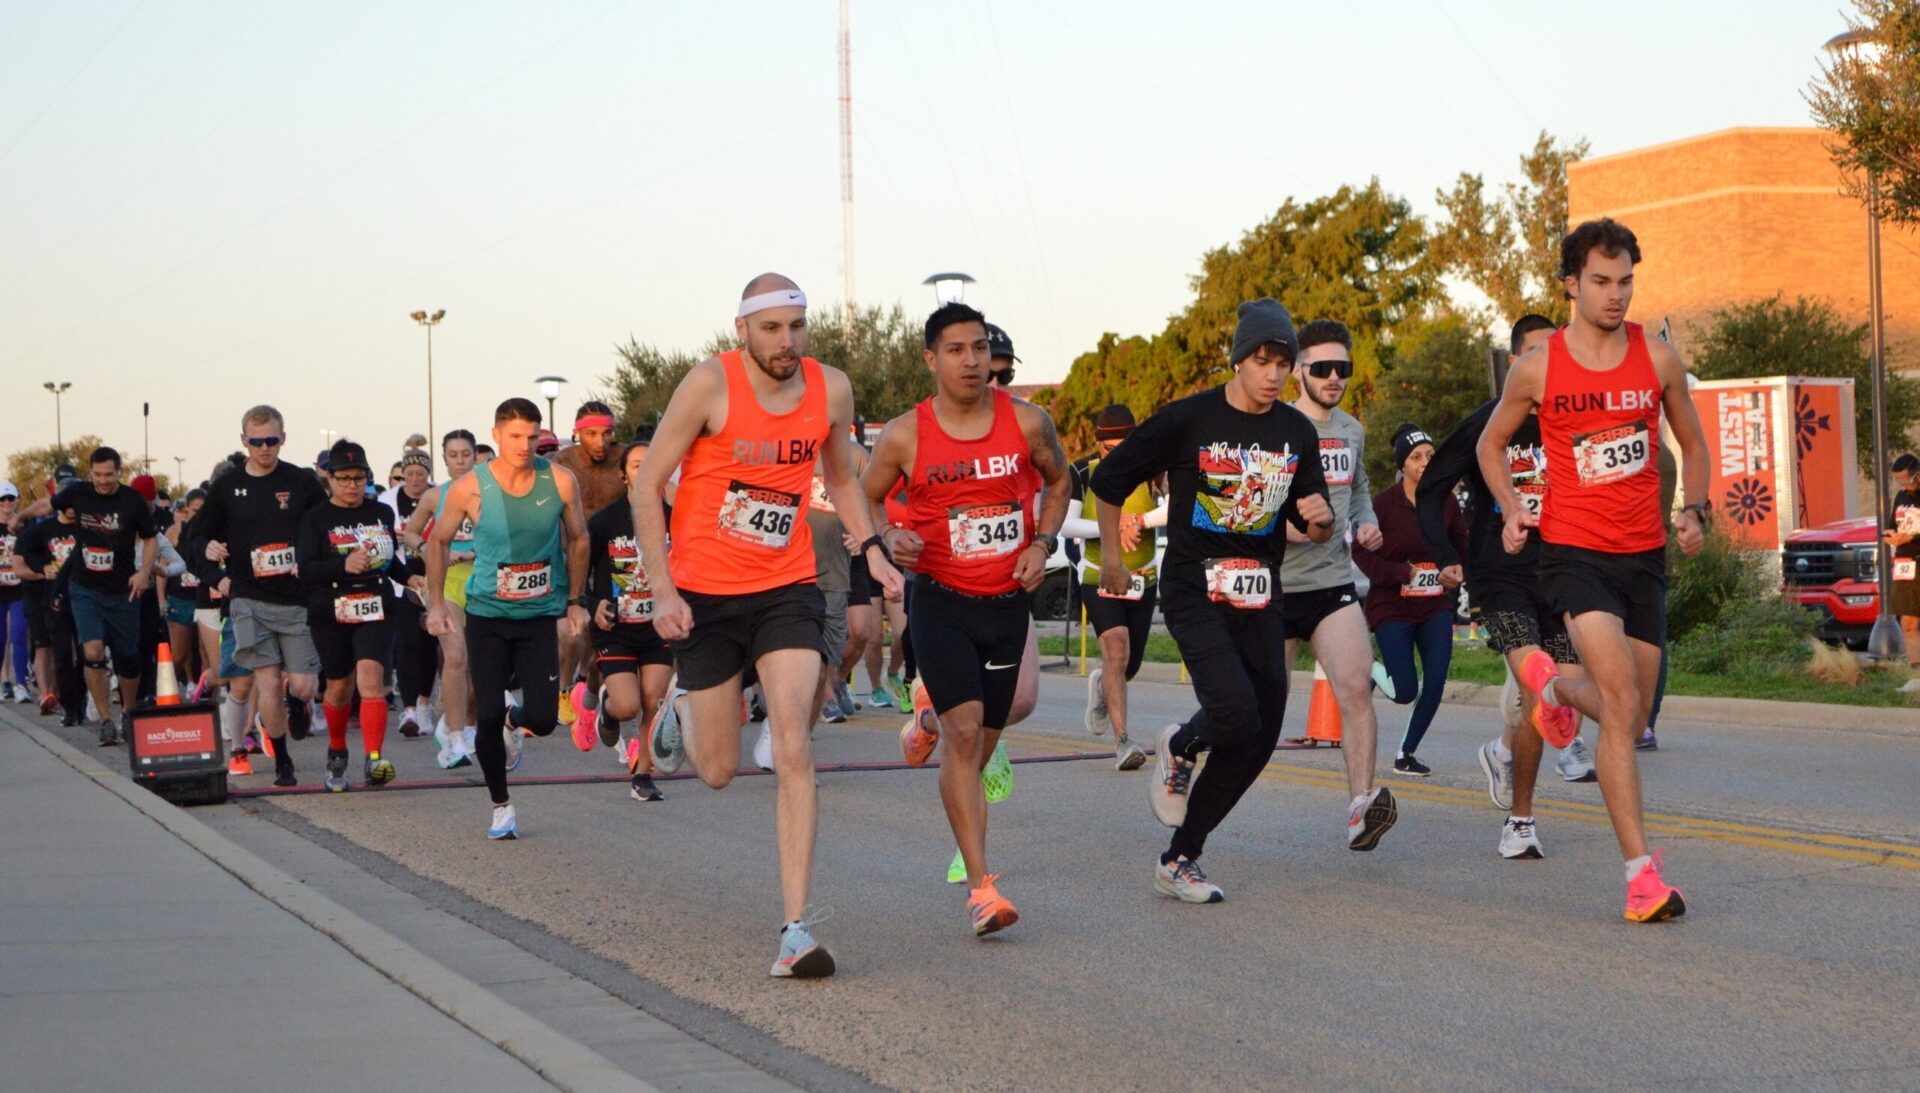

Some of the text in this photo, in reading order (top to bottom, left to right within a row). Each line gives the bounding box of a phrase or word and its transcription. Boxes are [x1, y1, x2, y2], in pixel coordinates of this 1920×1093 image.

[1555, 389, 1654, 413] RUNLBK
[1718, 392, 1745, 477] WEST
[733, 439, 817, 465] RUNLBK
[1321, 454, 1349, 471] 310
[1603, 439, 1645, 468] 339
[927, 453, 1019, 486] RUNLBK
[749, 509, 792, 536] 436
[978, 519, 1019, 545] 343
[91, 555, 111, 564] 214
[268, 552, 293, 567] 419
[518, 572, 547, 589] 288
[1233, 574, 1267, 595] 470
[353, 602, 379, 616] 156
